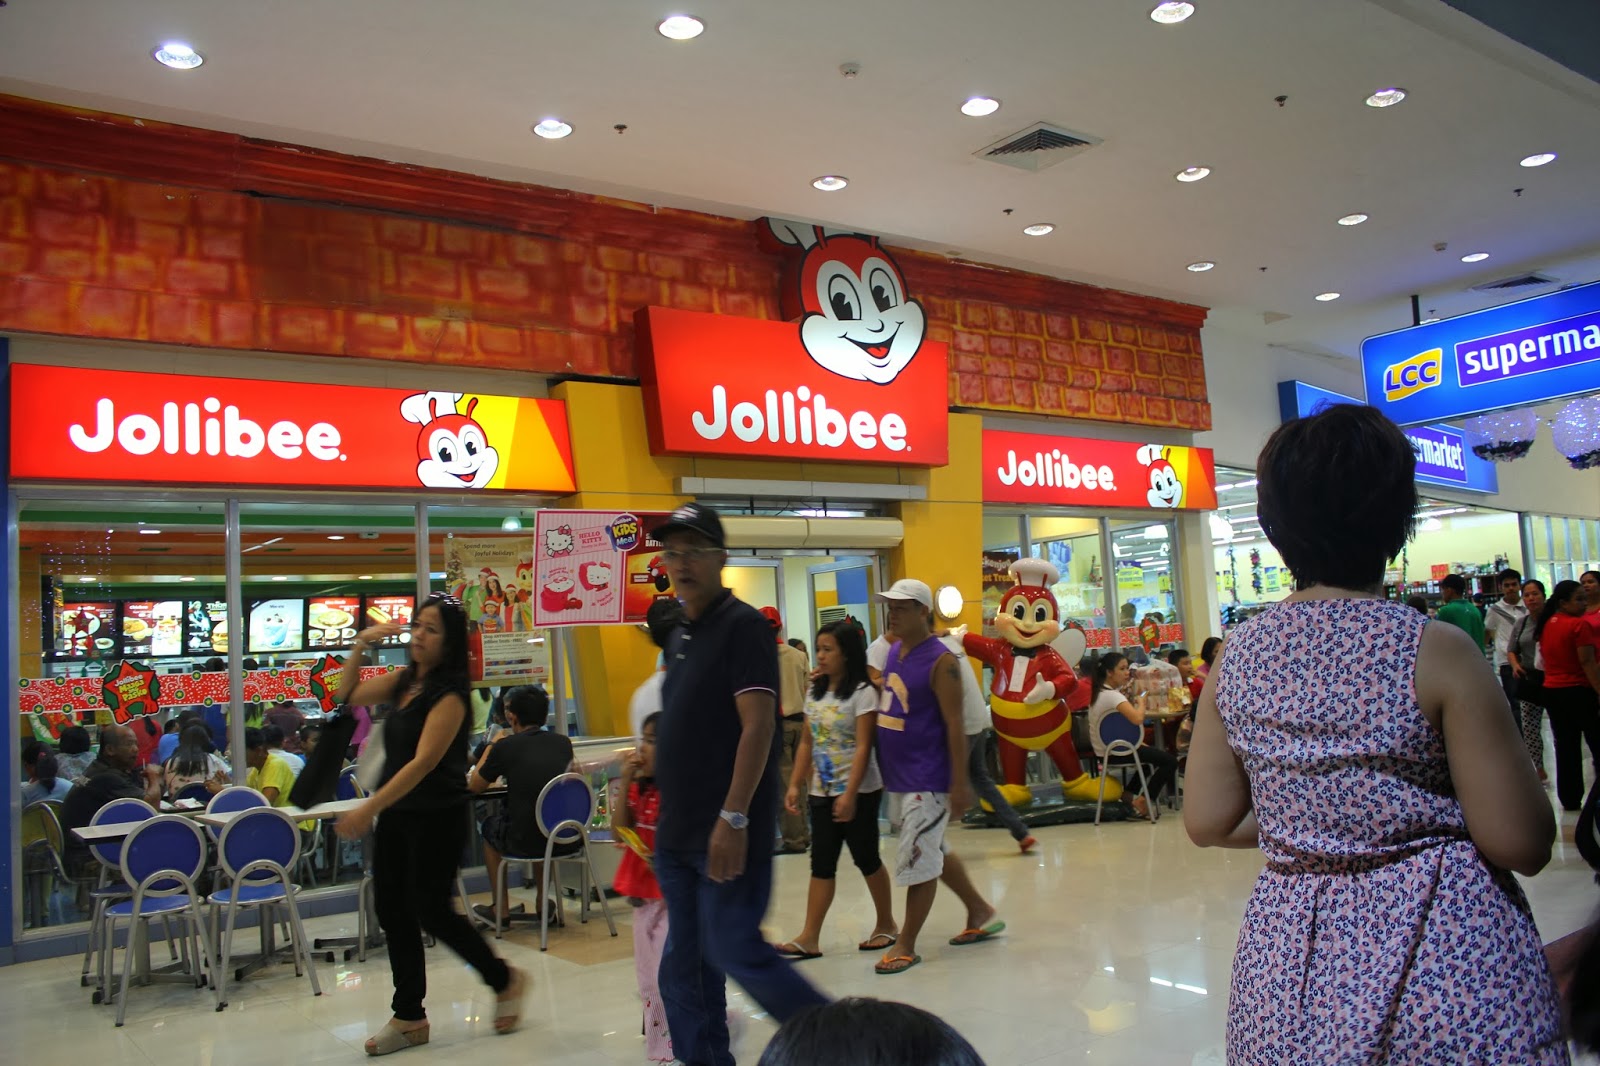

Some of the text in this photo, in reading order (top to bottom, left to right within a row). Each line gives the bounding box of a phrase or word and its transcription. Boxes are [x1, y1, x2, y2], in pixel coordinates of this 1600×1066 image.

[1464, 324, 1600, 375] superma
[1385, 360, 1438, 392] LCC
[69, 397, 342, 462] Jollibee
[692, 385, 907, 452] Jollibee
[997, 449, 1115, 492] Jollibee
[578, 531, 601, 539] HELLO
[581, 536, 603, 544] KITTY
[616, 534, 636, 546] Meal
[114, 674, 143, 687] Jollibee
[122, 689, 148, 702] Pasko
